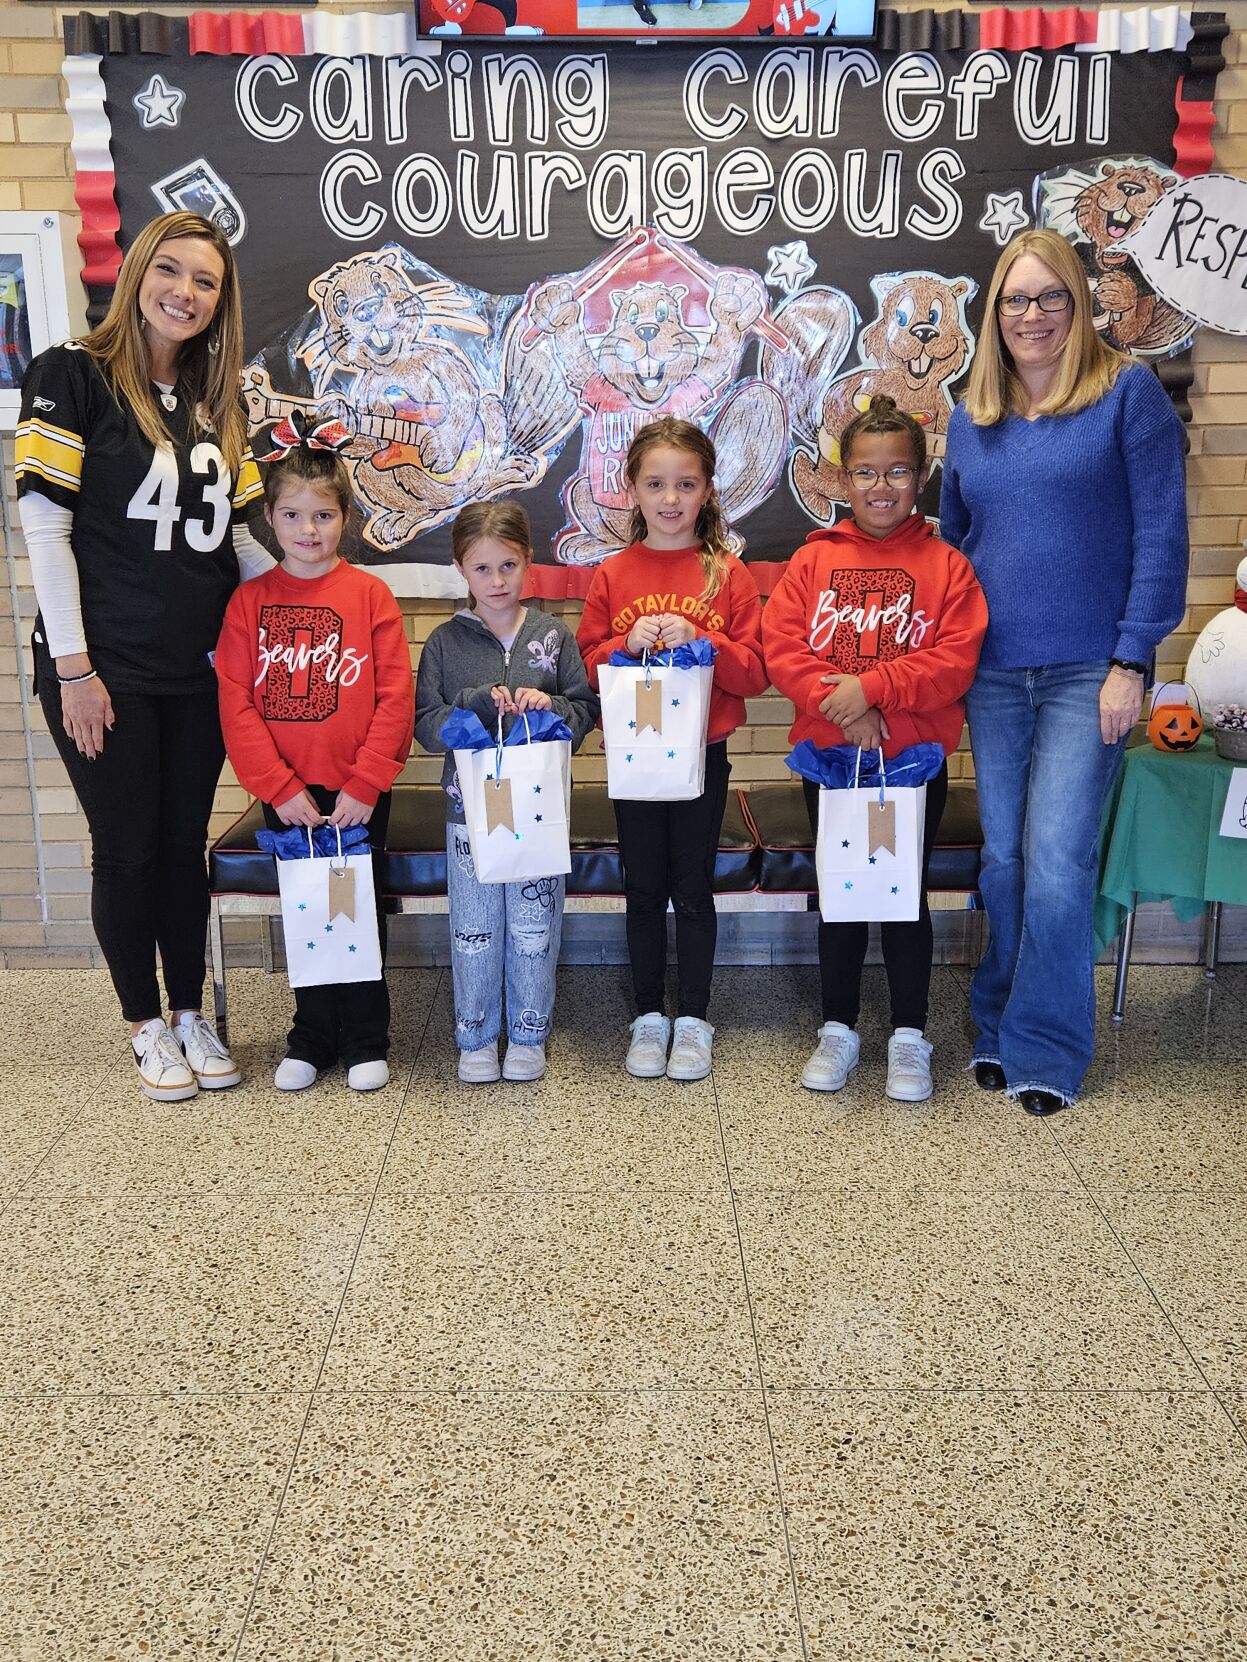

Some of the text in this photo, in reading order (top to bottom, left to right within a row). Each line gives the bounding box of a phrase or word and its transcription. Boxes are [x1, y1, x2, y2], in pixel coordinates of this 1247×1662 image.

[235, 47, 1112, 150] caring careful
[319, 147, 967, 241] courageous
[1155, 192, 1247, 290] RESP
[126, 440, 232, 553] 43
[611, 593, 725, 634] GO TAYLOR'S
[809, 589, 935, 651] Beavers
